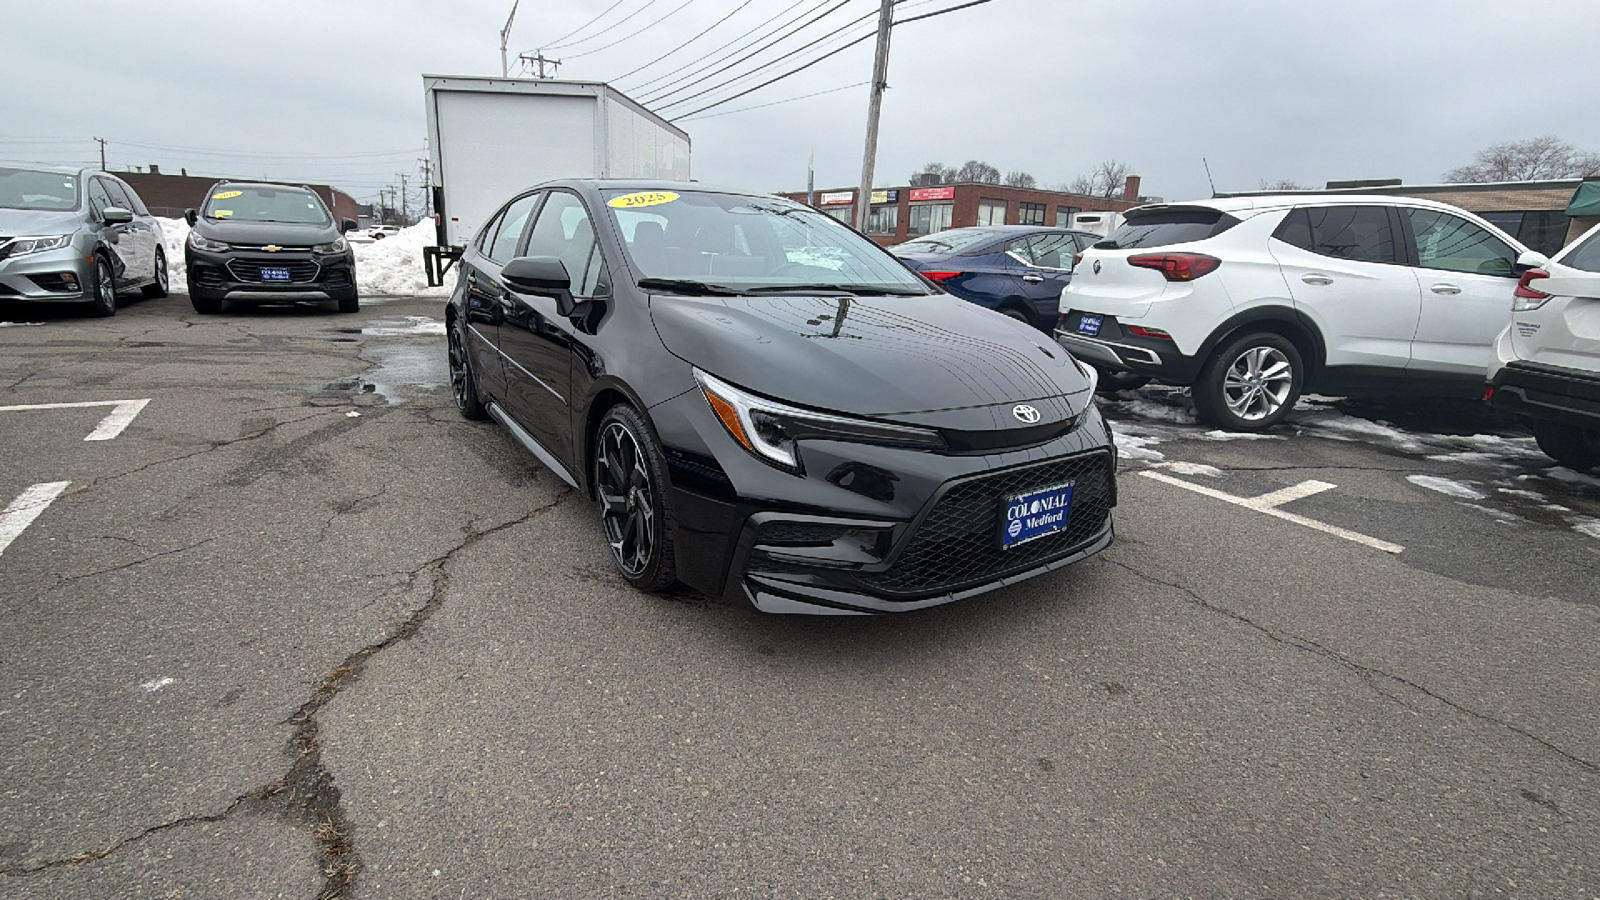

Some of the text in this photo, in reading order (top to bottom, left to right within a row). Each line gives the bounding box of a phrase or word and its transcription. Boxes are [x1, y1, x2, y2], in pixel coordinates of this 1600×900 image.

[622, 193, 666, 206] 2025
[1007, 493, 1068, 521] COLONIAL
[1025, 510, 1064, 530] Medford
